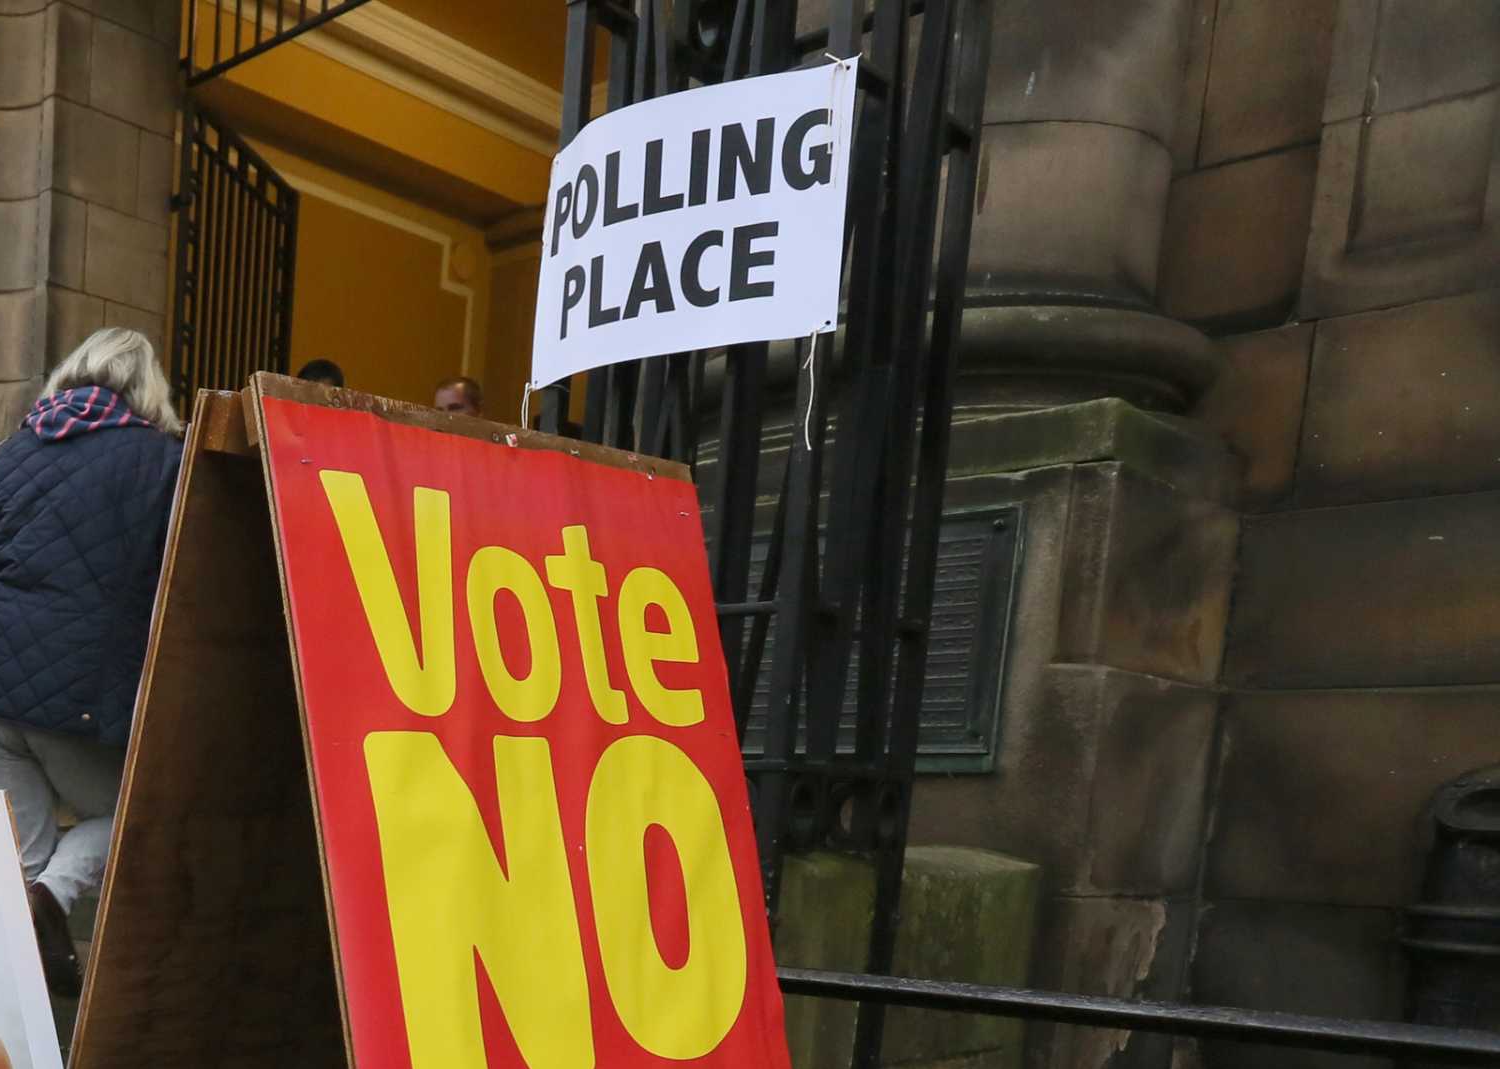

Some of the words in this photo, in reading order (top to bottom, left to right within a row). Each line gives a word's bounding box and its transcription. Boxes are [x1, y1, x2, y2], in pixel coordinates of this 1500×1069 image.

[550, 107, 832, 257] POLLING
[560, 220, 779, 341] PLACE
[318, 469, 705, 728] Vote
